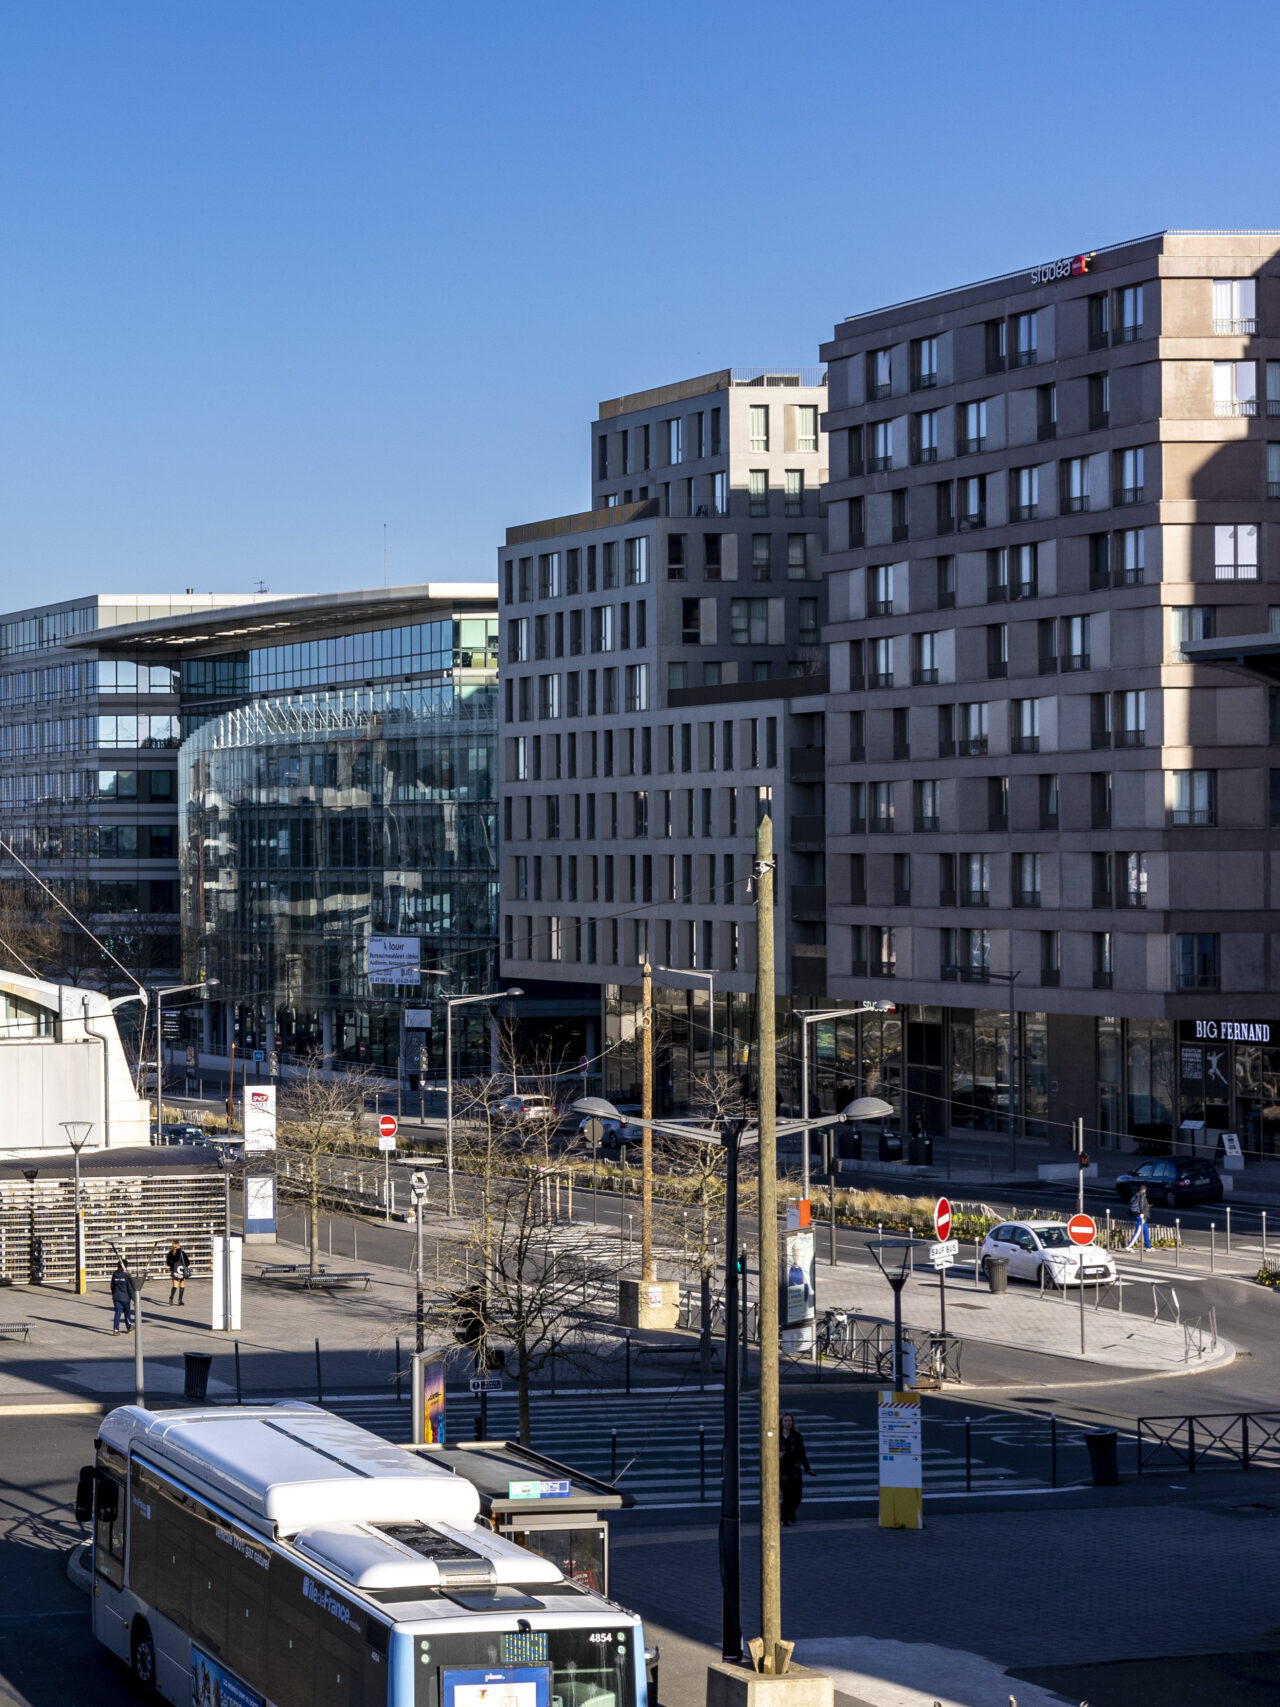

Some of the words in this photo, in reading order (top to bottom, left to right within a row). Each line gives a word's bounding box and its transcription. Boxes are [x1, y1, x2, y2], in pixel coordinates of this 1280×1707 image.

[1196, 1021, 1218, 1038] BIG
[1221, 1022, 1270, 1042] FERNAND
[932, 1247, 945, 1256] SAUF
[946, 1244, 956, 1253] BUS
[589, 1632, 613, 1643] 4854
